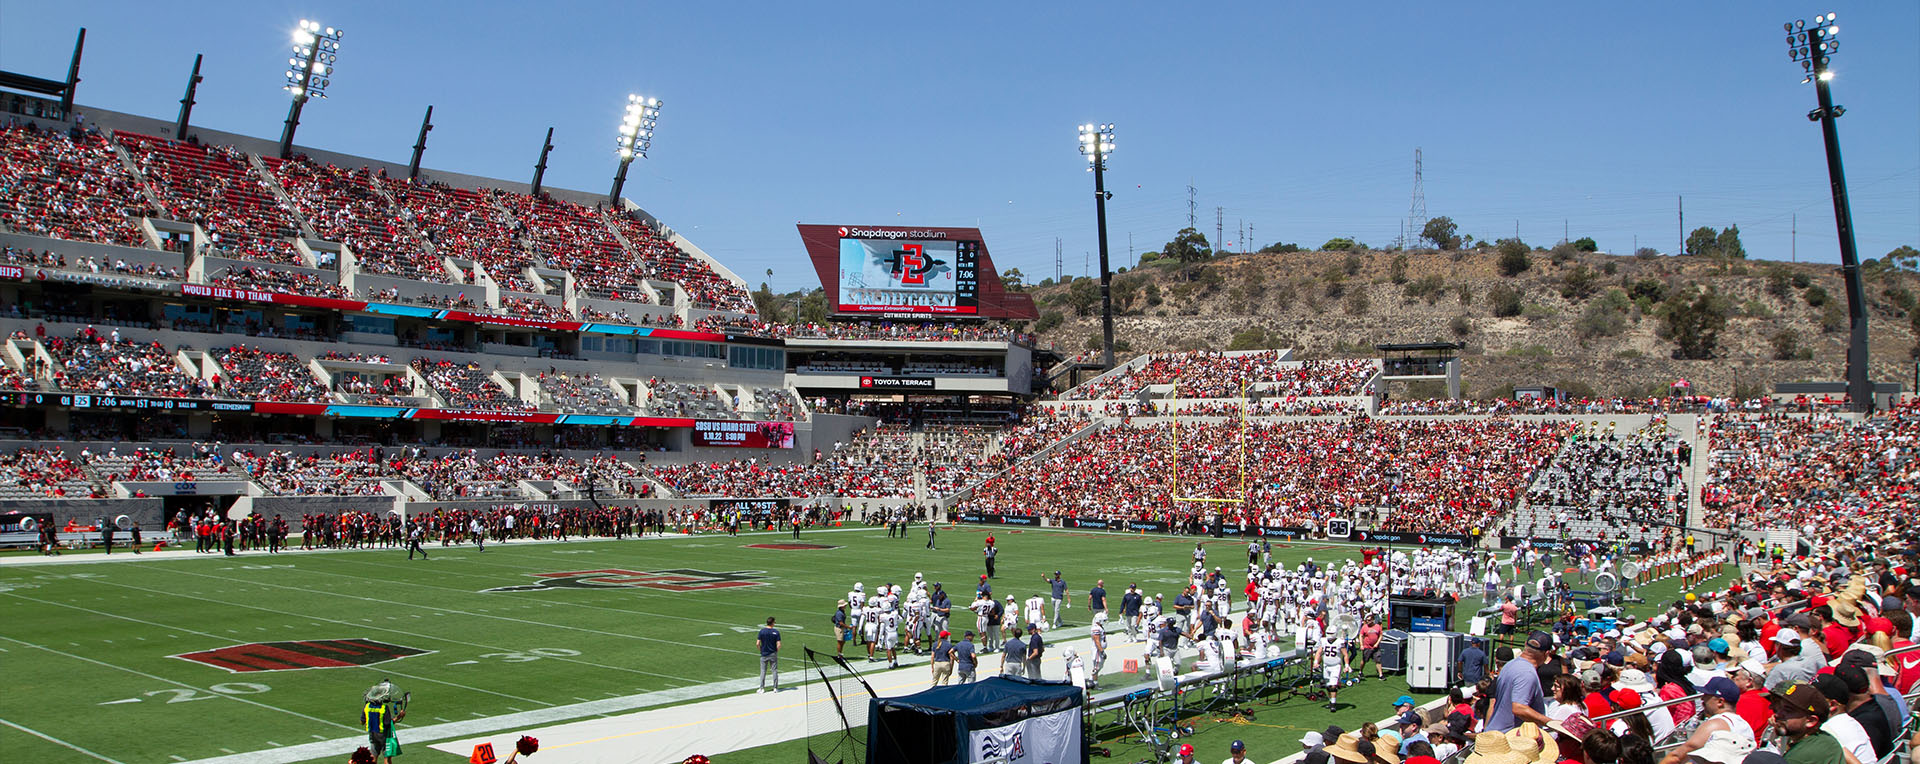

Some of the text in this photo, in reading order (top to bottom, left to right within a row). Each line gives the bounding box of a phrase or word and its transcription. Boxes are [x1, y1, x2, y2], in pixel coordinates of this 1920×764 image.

[852, 228, 946, 239] Snapdragon stadium
[959, 270, 974, 279] 7:06
[183, 285, 272, 302] WOULD LIKE TO THANK
[96, 396, 116, 406] 7:06
[164, 400, 174, 408] 10
[696, 422, 757, 432] SDSU VS IDAHO STATE
[704, 432, 722, 440] 9.10.22
[734, 502, 750, 510] ALL
[1428, 536, 1462, 544] Snapdragon
[1314, 582, 1322, 591] 42
[852, 596, 858, 606] 5
[1031, 600, 1038, 610] 11
[866, 611, 876, 623] 16
[888, 617, 894, 628] 3
[479, 648, 582, 663] 30
[1324, 646, 1337, 657] 55
[1124, 660, 1136, 671] 40
[144, 682, 273, 704] 20
[1010, 732, 1024, 762] A
[478, 744, 496, 762] 20
